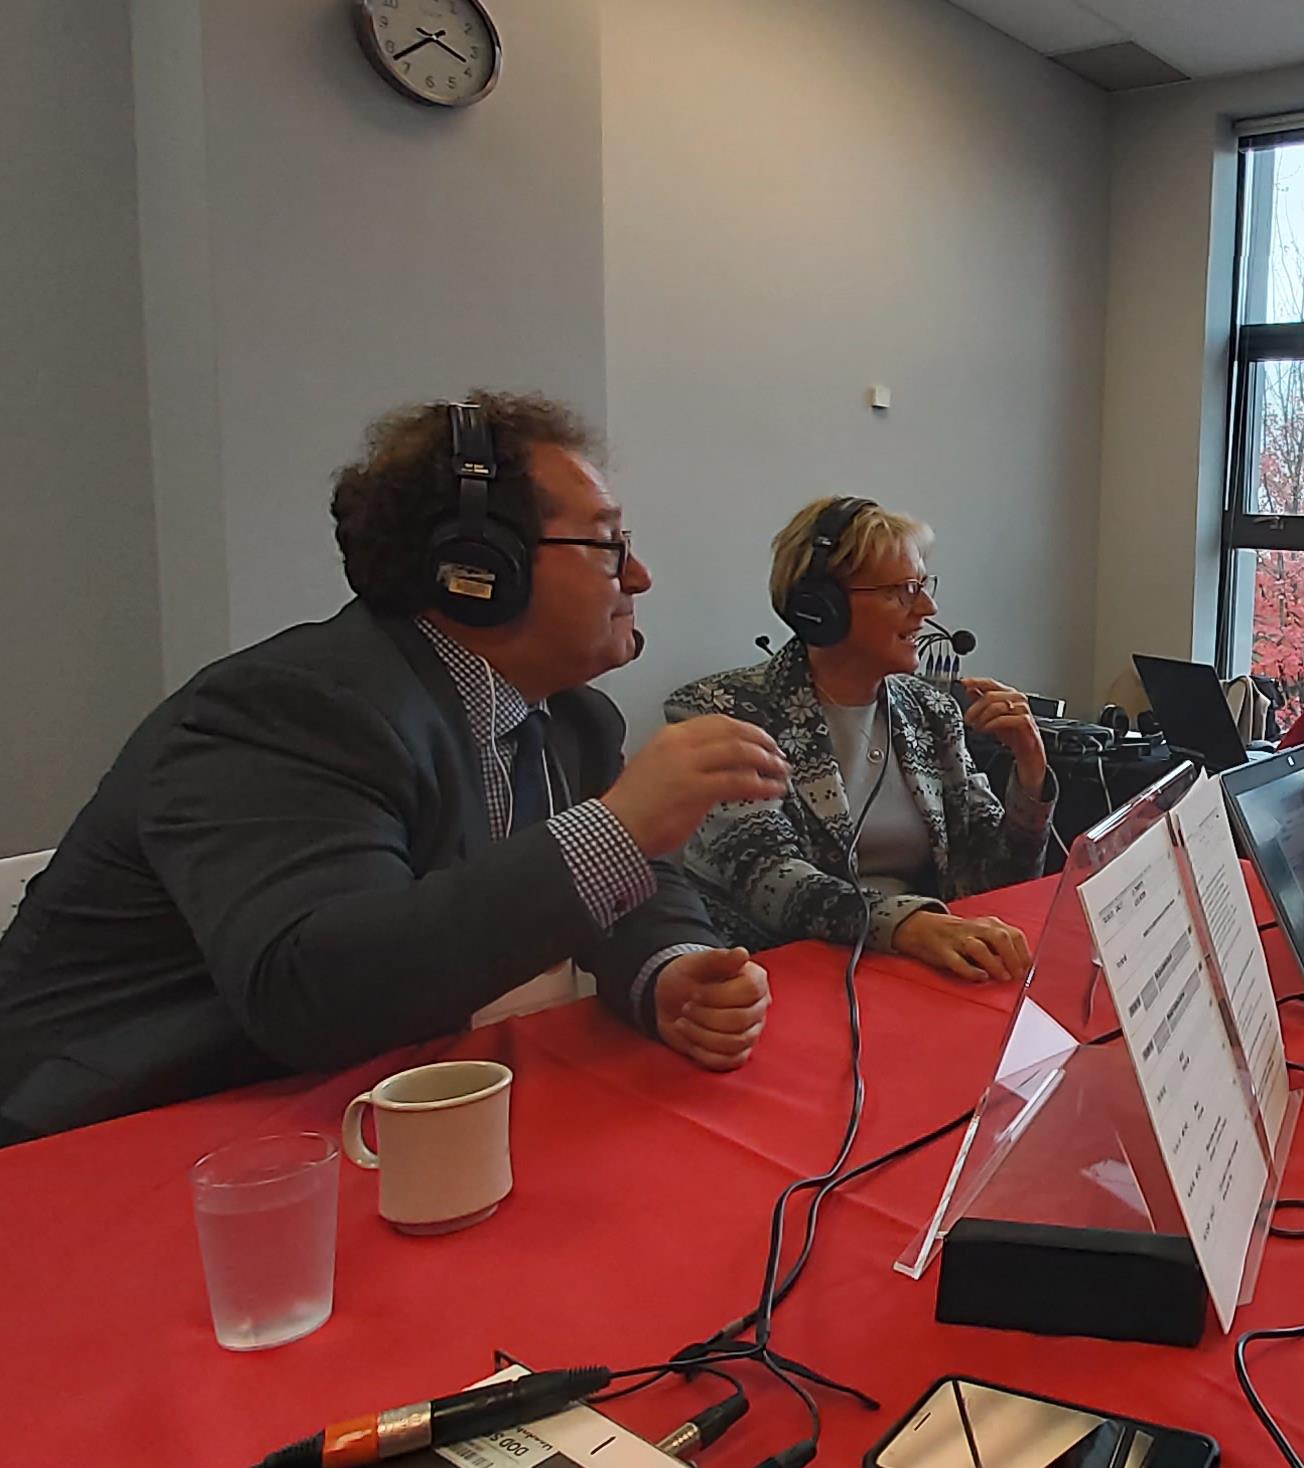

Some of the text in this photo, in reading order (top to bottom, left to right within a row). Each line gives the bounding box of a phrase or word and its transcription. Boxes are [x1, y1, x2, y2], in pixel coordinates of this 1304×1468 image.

[464, 22, 473, 35] 2
[470, 46, 479, 59] 3
[403, 62, 411, 76] 7
[425, 75, 436, 89] 6
[446, 76, 457, 89] 5
